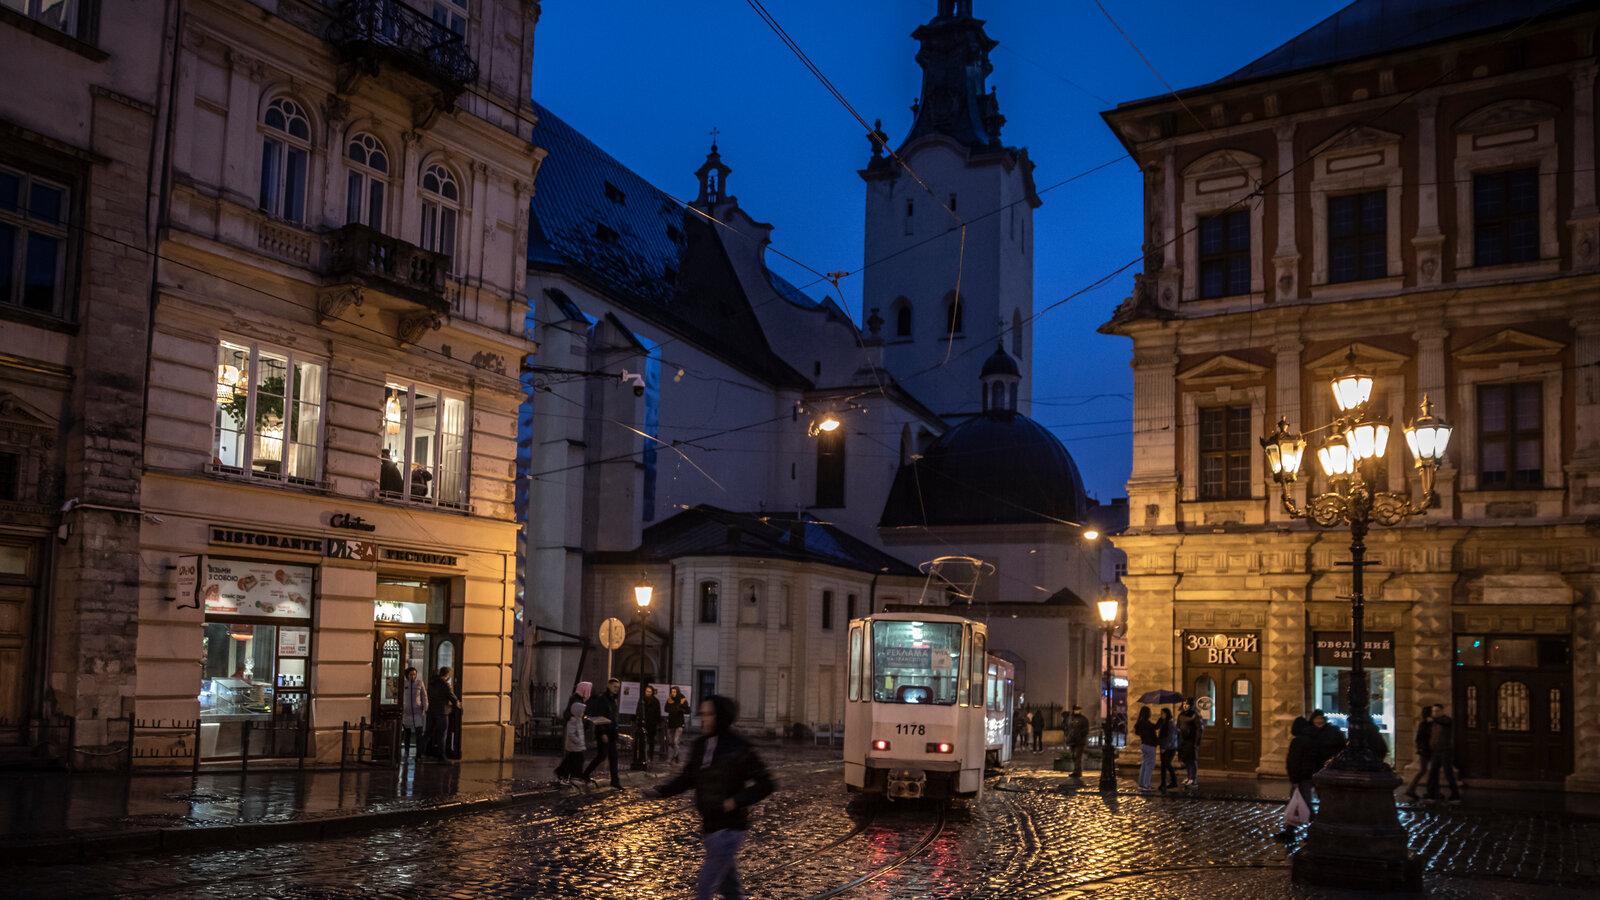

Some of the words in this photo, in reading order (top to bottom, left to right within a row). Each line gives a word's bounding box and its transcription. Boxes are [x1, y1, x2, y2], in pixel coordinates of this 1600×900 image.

[213, 530, 322, 551] RISTORANTE
[1208, 648, 1237, 665] ВІК
[896, 724, 925, 736] 1178
